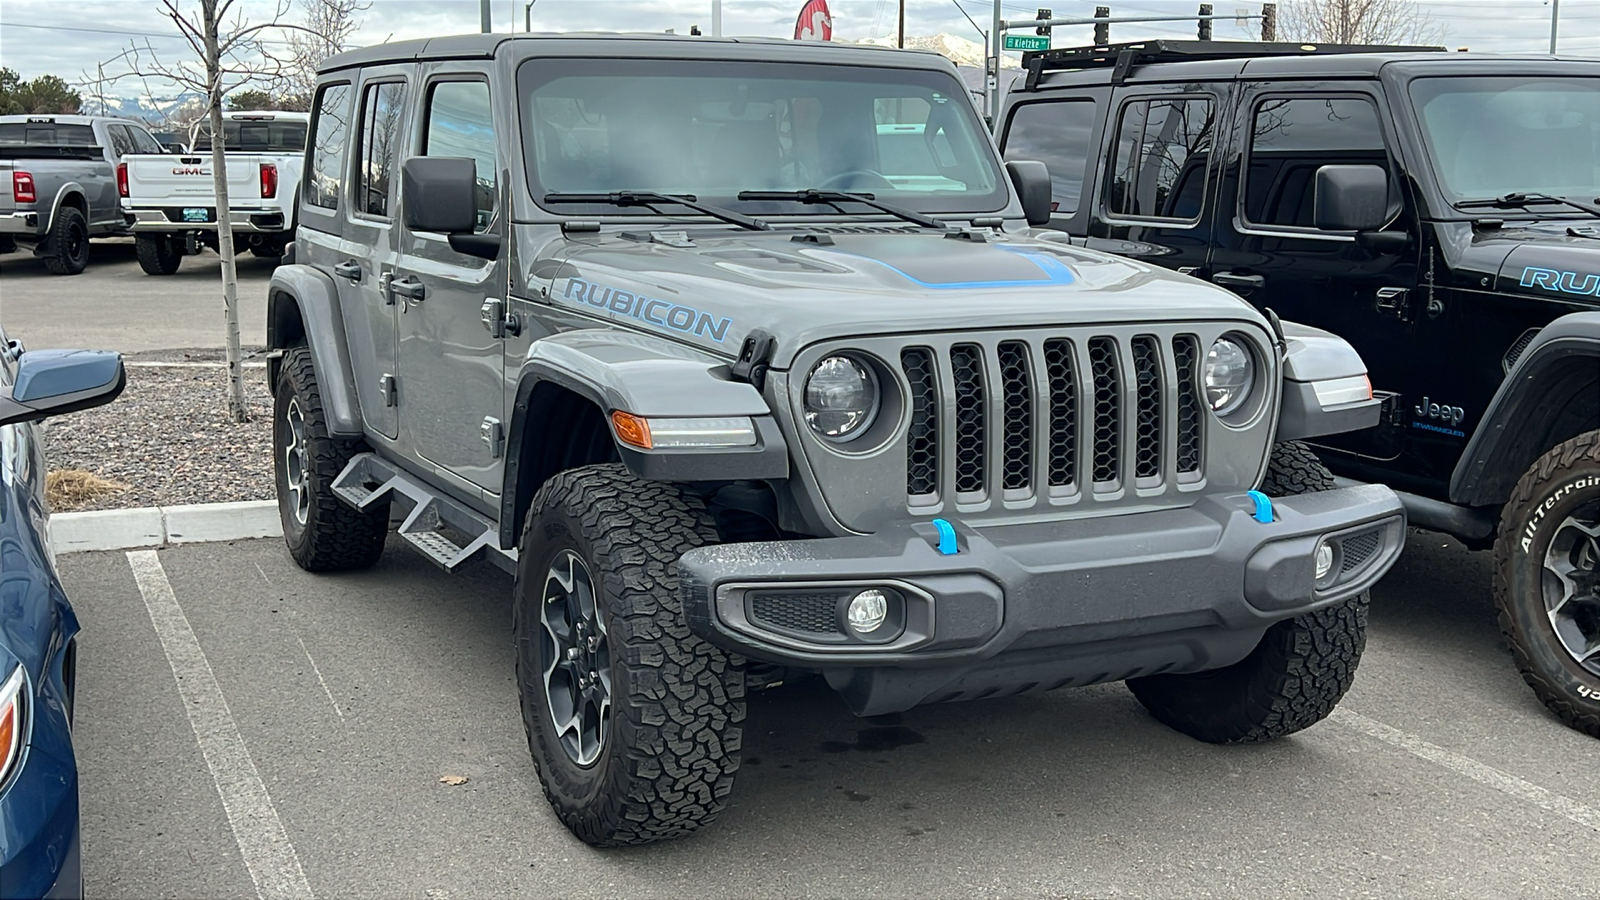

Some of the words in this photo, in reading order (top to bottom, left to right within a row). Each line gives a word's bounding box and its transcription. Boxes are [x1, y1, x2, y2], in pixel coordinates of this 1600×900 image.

[1014, 38, 1040, 49] Kietzke
[172, 168, 212, 176] GMC
[1519, 266, 1600, 297] RU
[563, 277, 733, 343] RUBICON
[1415, 396, 1465, 427] Jeep
